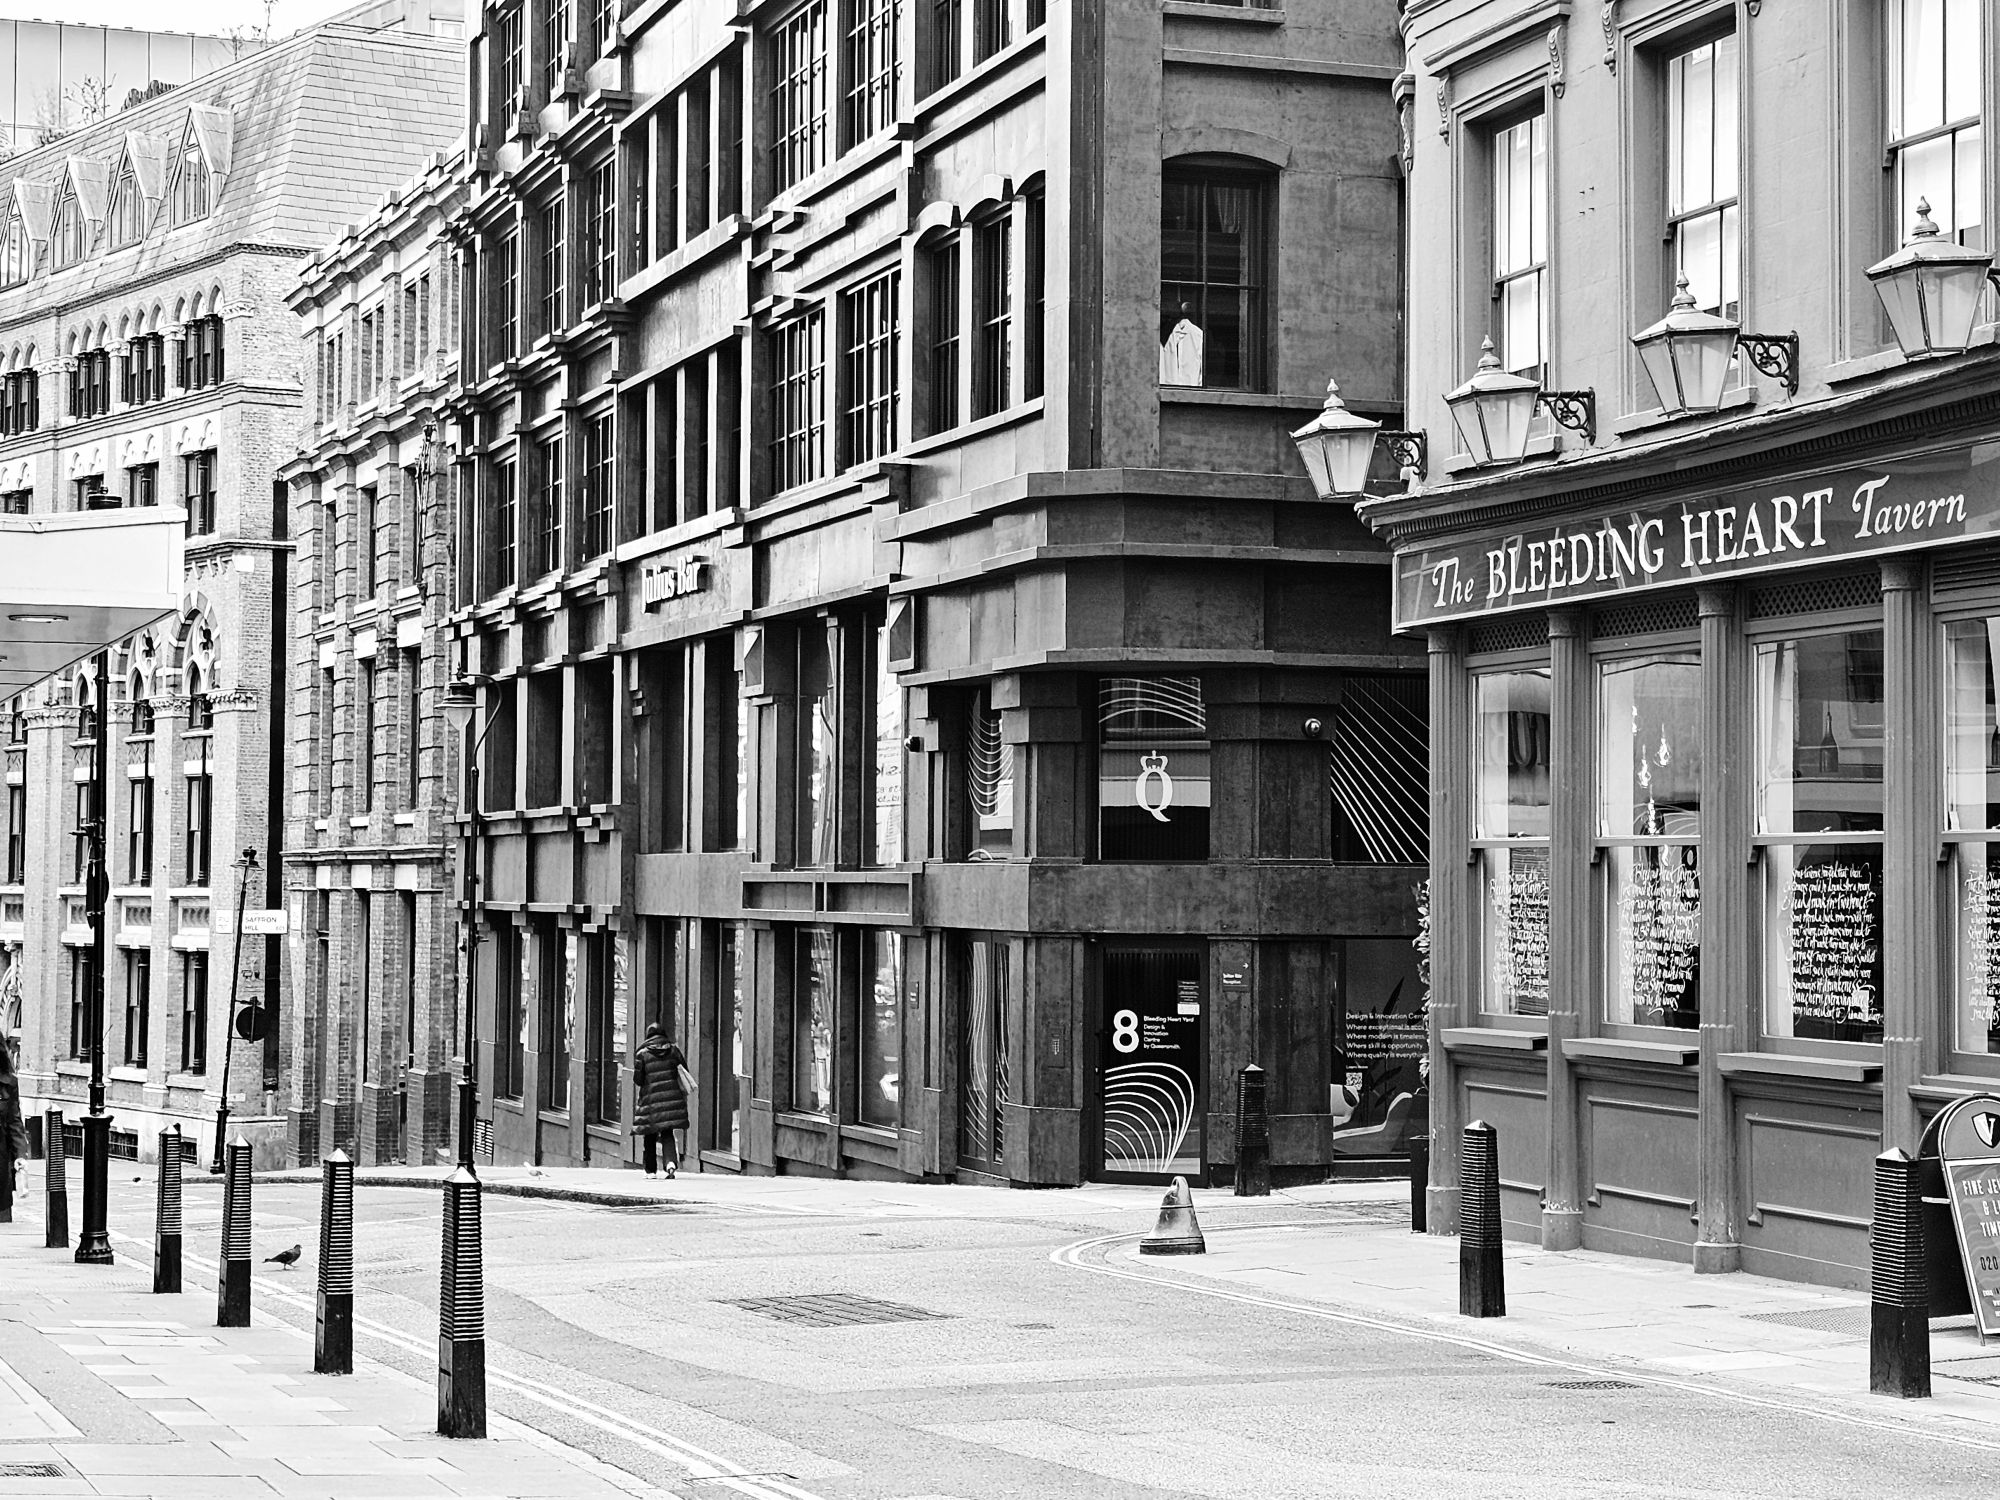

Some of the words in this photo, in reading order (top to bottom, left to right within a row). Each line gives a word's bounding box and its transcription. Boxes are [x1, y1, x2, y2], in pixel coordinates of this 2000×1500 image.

[1432, 556, 1474, 608] The
[1486, 518, 1665, 600] BLEEDING
[1680, 487, 1833, 568] HEART
[1852, 474, 1967, 539] Tavern
[640, 564, 675, 614] Julius
[1346, 1012, 1369, 1021] Design
[1375, 1012, 1408, 1020] Innovation
[1113, 1009, 1140, 1054] 8
[1346, 1023, 1367, 1031] Where
[1346, 1032, 1367, 1040] Where
[1346, 1041, 1367, 1049] Where
[1346, 1050, 1367, 1058] Where
[1367, 1051, 1389, 1060] quality
[1961, 1179, 1984, 1196] FINE
[1980, 1255, 1999, 1271] 020
